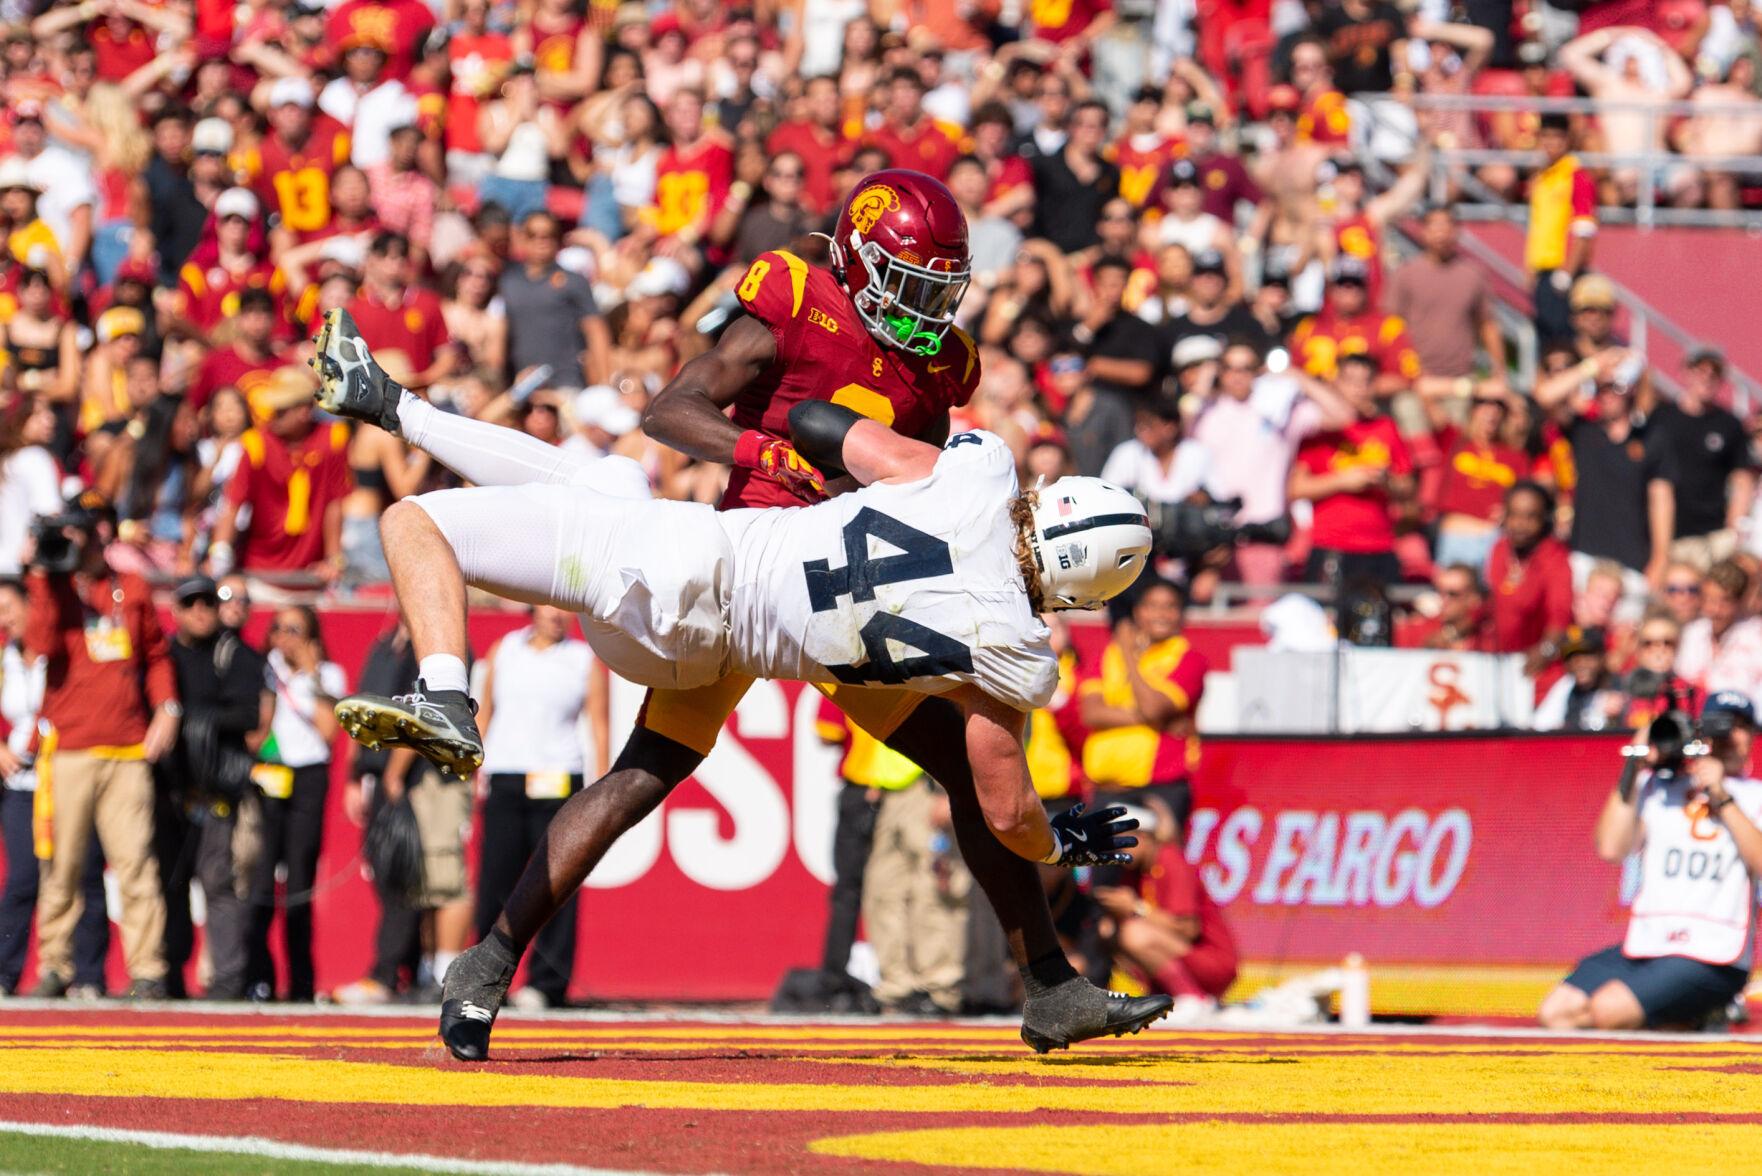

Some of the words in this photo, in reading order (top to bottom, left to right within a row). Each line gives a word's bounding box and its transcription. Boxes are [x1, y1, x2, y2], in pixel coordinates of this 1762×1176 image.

[738, 260, 771, 302] 8
[803, 506, 975, 685] 44
[1252, 808, 1472, 907] FARGO
